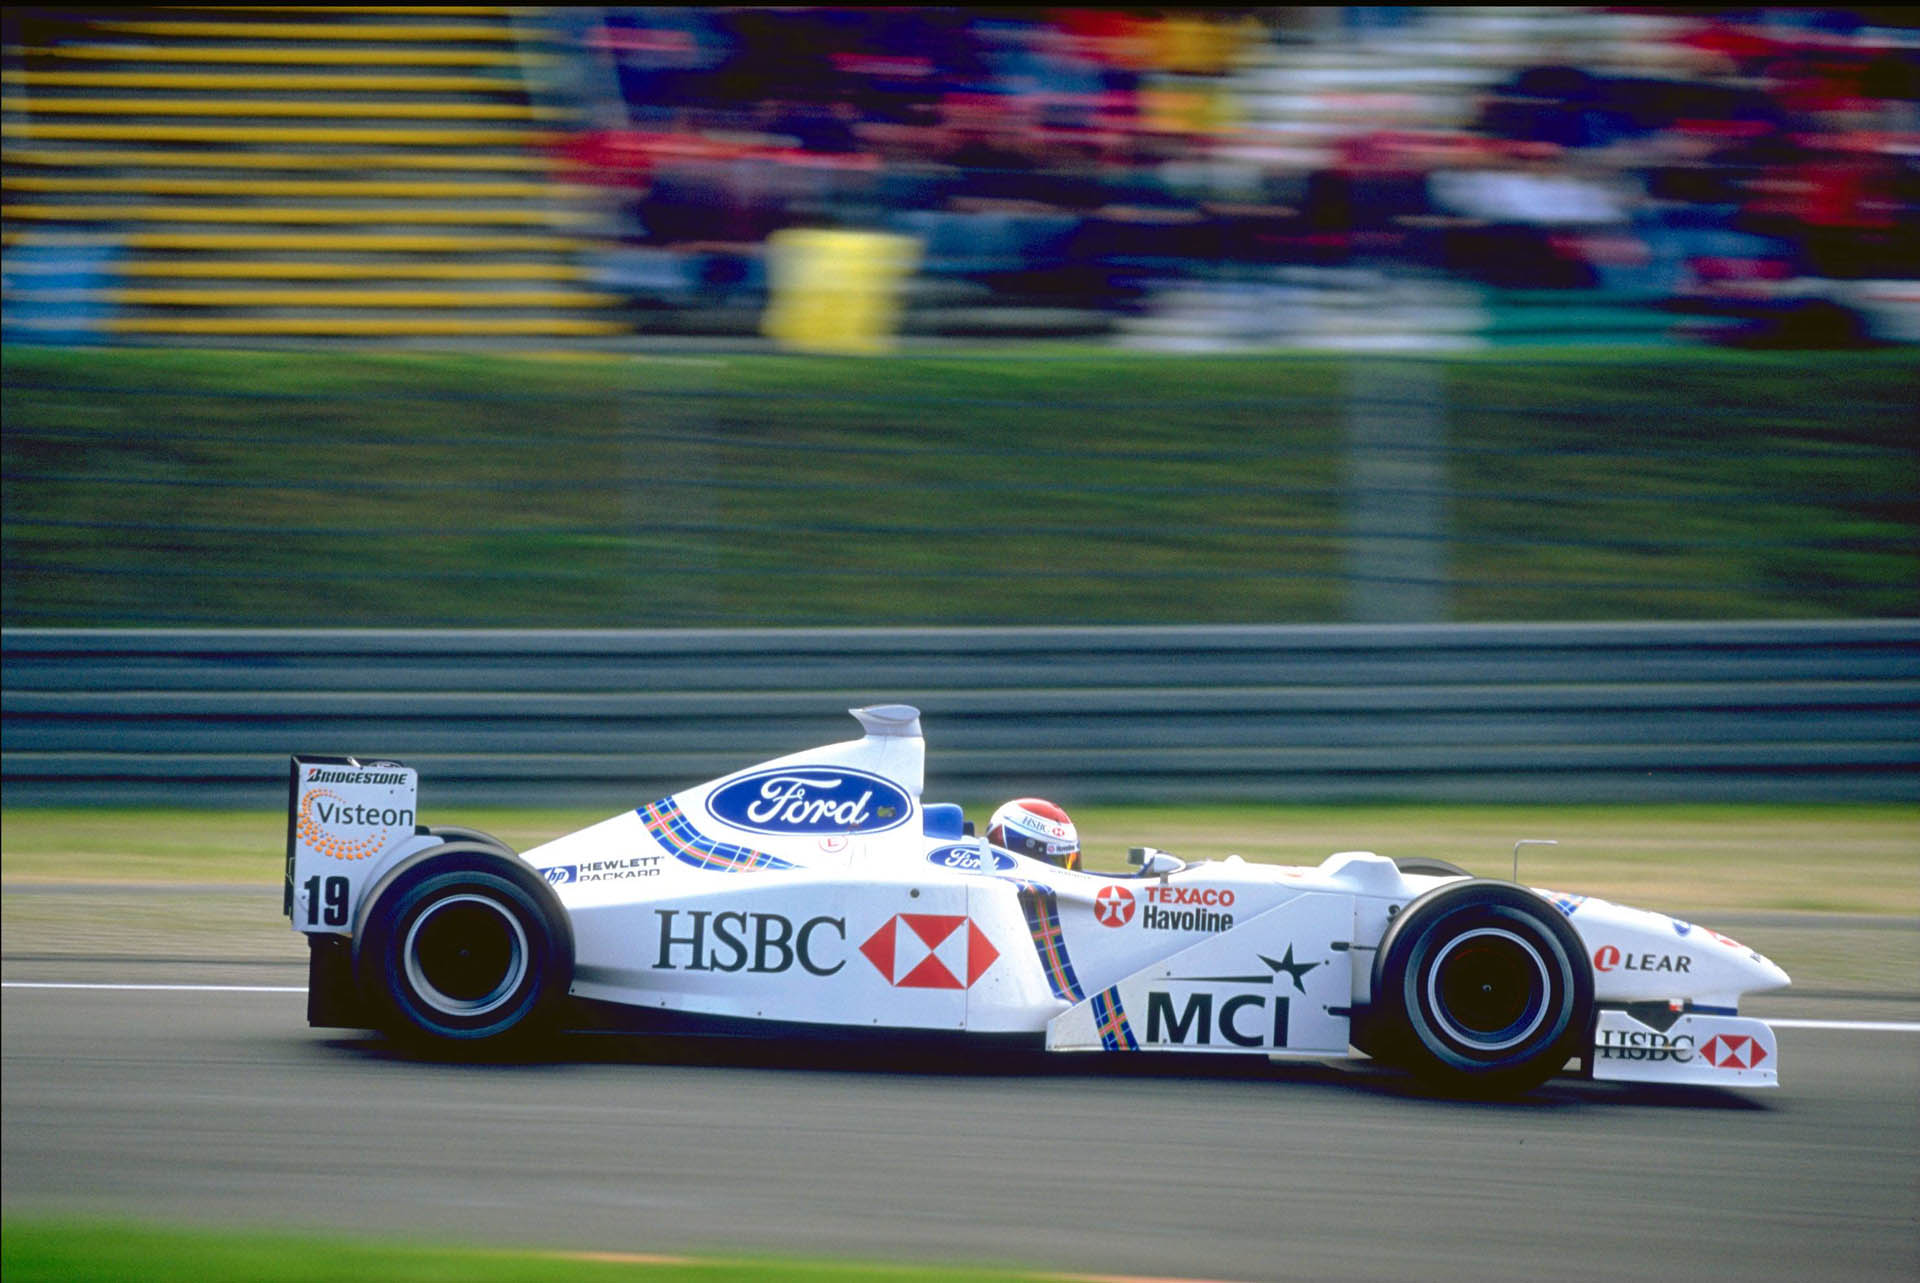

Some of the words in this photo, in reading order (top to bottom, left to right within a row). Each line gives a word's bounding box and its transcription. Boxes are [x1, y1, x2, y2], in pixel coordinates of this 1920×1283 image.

[307, 768, 408, 785] BRIDGESTONE
[747, 776, 873, 824] Ford
[317, 802, 414, 827] Visteon
[579, 855, 662, 872] HEWLETT
[579, 868, 661, 882] PACKARD
[304, 875, 350, 927] 19
[1144, 886, 1236, 908] TEXACO
[1142, 904, 1235, 933] Havoline
[651, 909, 847, 977] HSBC
[1624, 953, 1692, 973] LEAR
[1146, 991, 1290, 1048] MCI
[1600, 1030, 1695, 1063] HSBC
